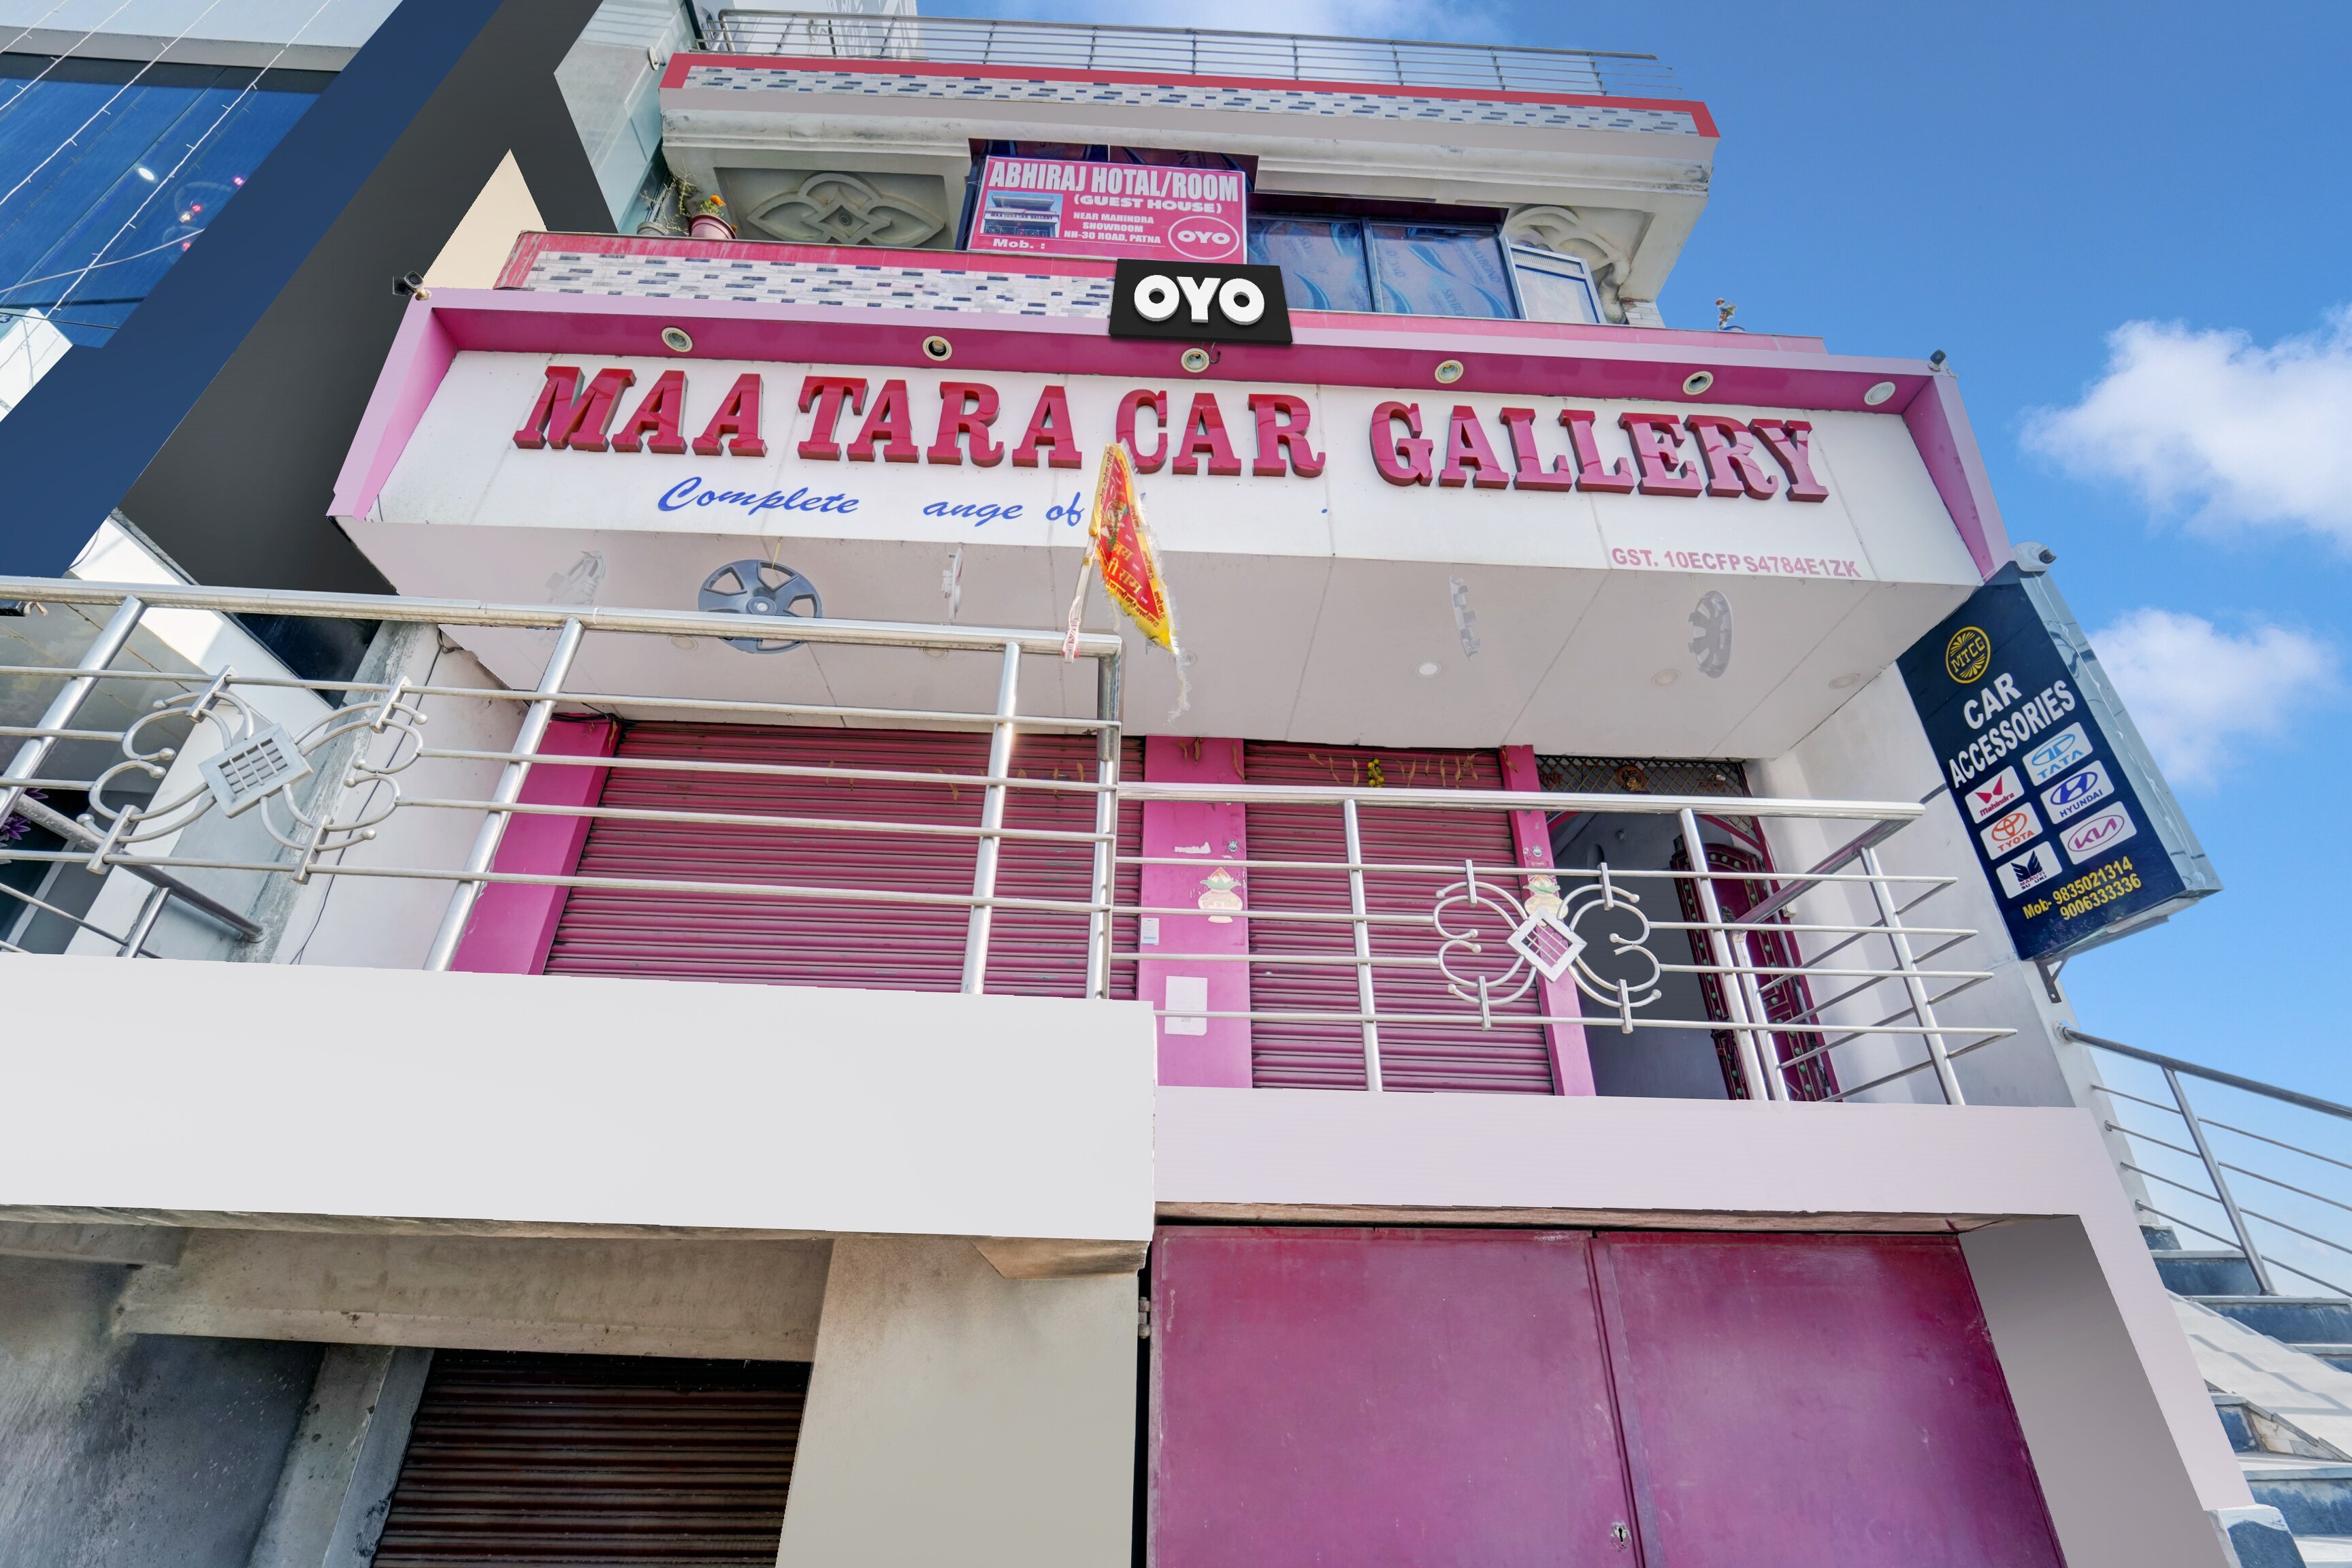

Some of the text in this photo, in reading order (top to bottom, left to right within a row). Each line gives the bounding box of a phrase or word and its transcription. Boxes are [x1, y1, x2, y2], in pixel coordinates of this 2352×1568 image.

[989, 161, 1239, 202] ABHIRAJ HOTAL/ROOM
[1074, 194, 1222, 214] (GUEST HOUSE)
[1073, 212, 1154, 224] NEAR MAHINDRA
[1083, 222, 1143, 233] SHOWROOM
[993, 238, 1034, 248] Mob.
[1064, 230, 1096, 240] NH-30
[1130, 235, 1161, 244] PATNA
[1177, 230, 1230, 244] OYO
[1134, 274, 1264, 325] OYO
[512, 366, 768, 457] MAA
[797, 376, 1083, 470] TARA
[1115, 389, 1326, 479] CAR
[1369, 401, 1829, 503] GALLERY
[657, 476, 860, 516] Complete
[1046, 491, 1085, 527] of
[1612, 548, 1659, 567] GST.
[1963, 672, 2022, 730] CAR
[1948, 680, 2076, 789] ACCESSORIES
[2037, 749, 2084, 779] TATA
[1980, 793, 2014, 817] Mahindra
[2059, 789, 2104, 817] HYUNDAI
[1997, 829, 2035, 852] TYOTA
[2020, 871, 2046, 887] MARUTI
[2022, 855, 2134, 919] Mob- 9835021314
[2059, 872, 2142, 920] 9006333336
